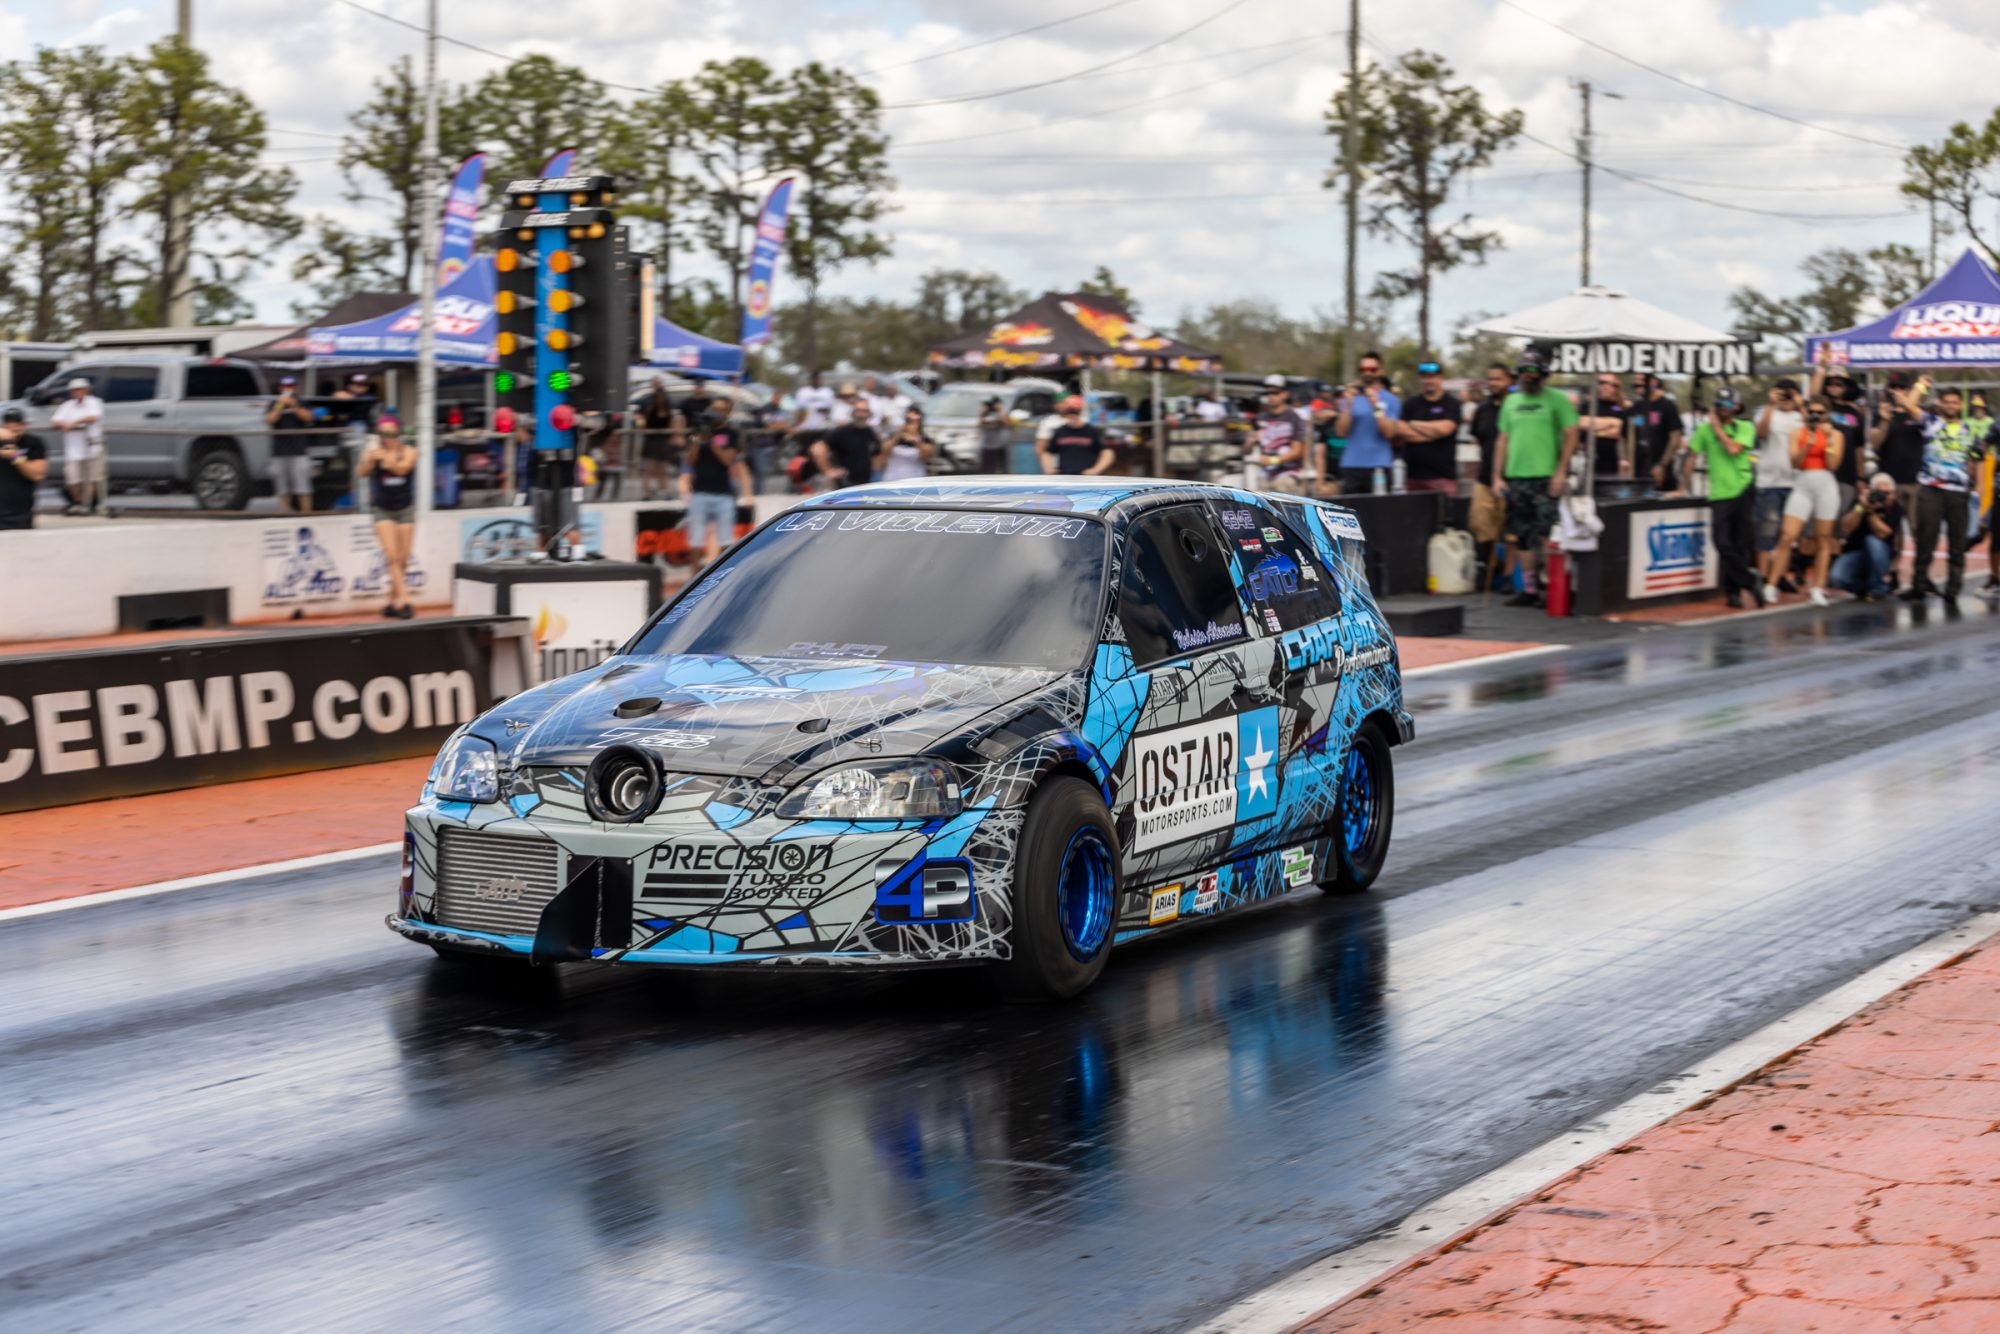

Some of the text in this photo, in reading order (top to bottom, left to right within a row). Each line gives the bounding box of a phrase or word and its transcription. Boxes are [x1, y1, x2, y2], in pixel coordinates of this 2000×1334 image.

[776, 511, 1087, 539] LA VIOLENTA
[1139, 731, 1234, 813] OSTAR
[1140, 795, 1233, 837] MOTORSPORTS.COM
[648, 843, 835, 871] PRECISION
[728, 886, 824, 900] BOOSTED
[731, 872, 827, 886] TURBO
[1154, 892, 1177, 912] ARIAS
